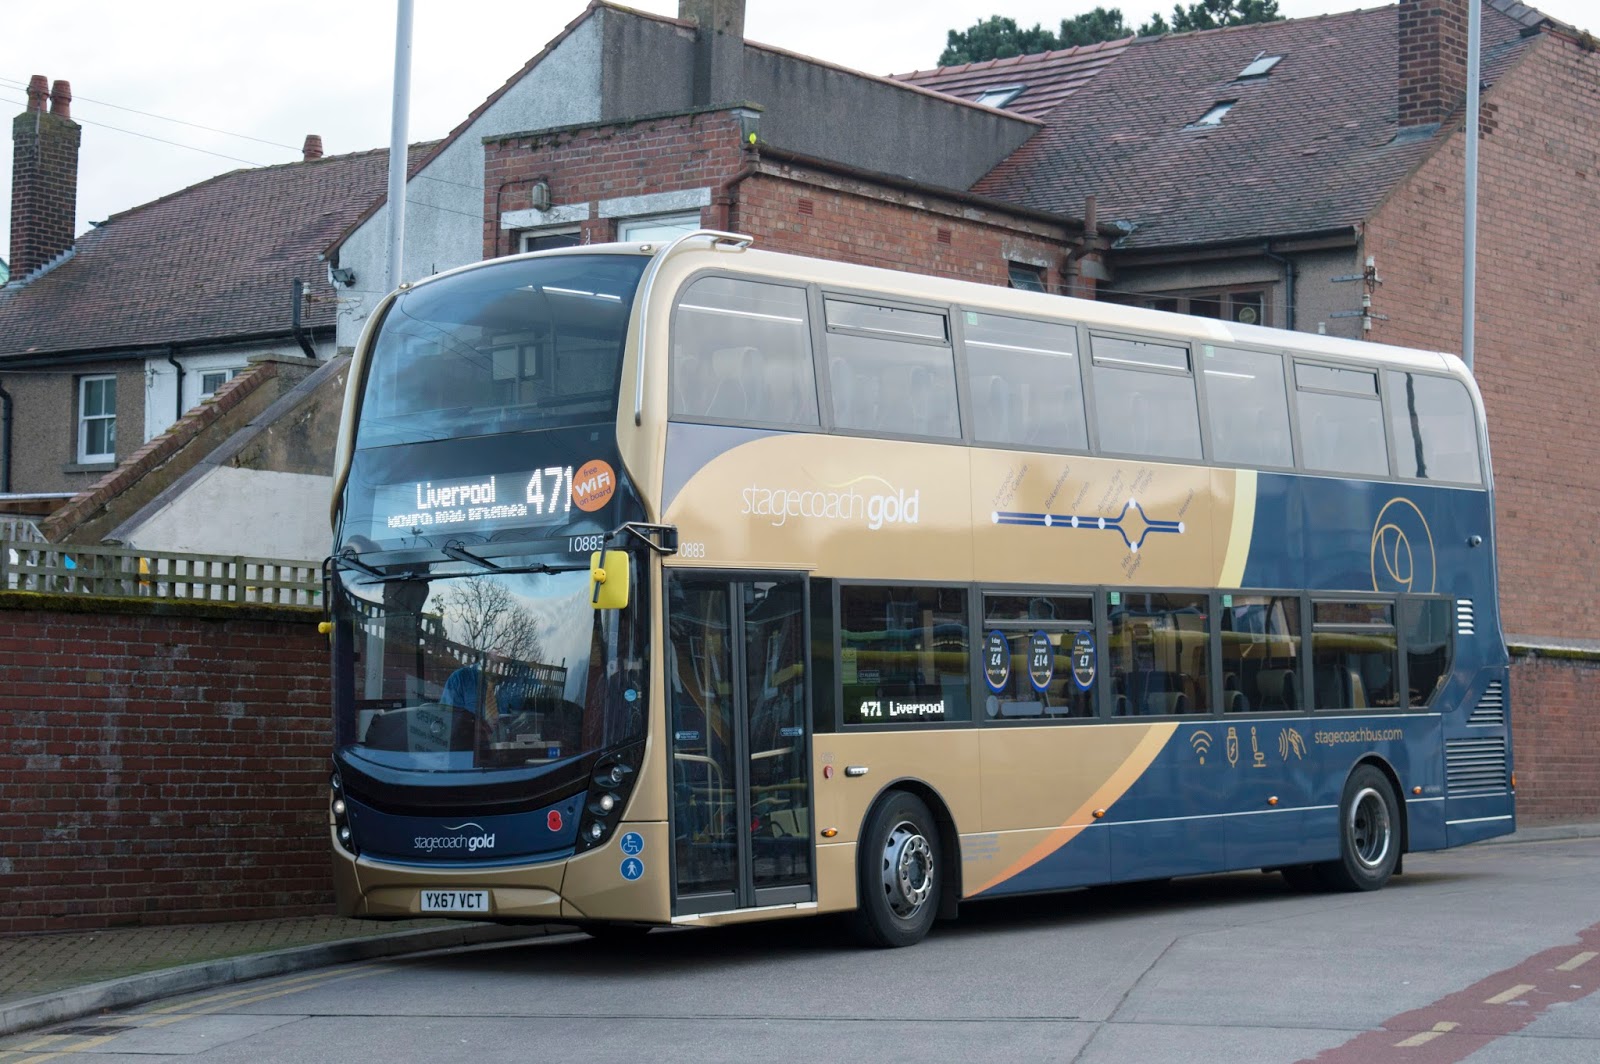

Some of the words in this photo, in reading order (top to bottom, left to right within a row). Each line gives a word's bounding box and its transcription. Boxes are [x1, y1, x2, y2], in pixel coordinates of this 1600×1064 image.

[583, 467, 598, 477] free
[417, 476, 496, 509] Liverpool
[527, 466, 573, 515] 471
[579, 498, 589, 506] on
[590, 486, 611, 501] board
[741, 483, 864, 527] stagecoach
[868, 488, 920, 531] gold
[568, 535, 604, 553] 10883
[676, 542, 705, 558] 0883
[991, 653, 1001, 666] £4
[1033, 654, 1049, 667] £14
[1080, 655, 1090, 667] £7
[860, 701, 882, 717] 471
[889, 700, 945, 716] Liverpool
[1314, 727, 1403, 747] stagecoachbus.com
[414, 834, 468, 853] stagecoach
[468, 833, 496, 852] gold
[426, 892, 456, 908] YX67
[459, 892, 482, 908] VCT
